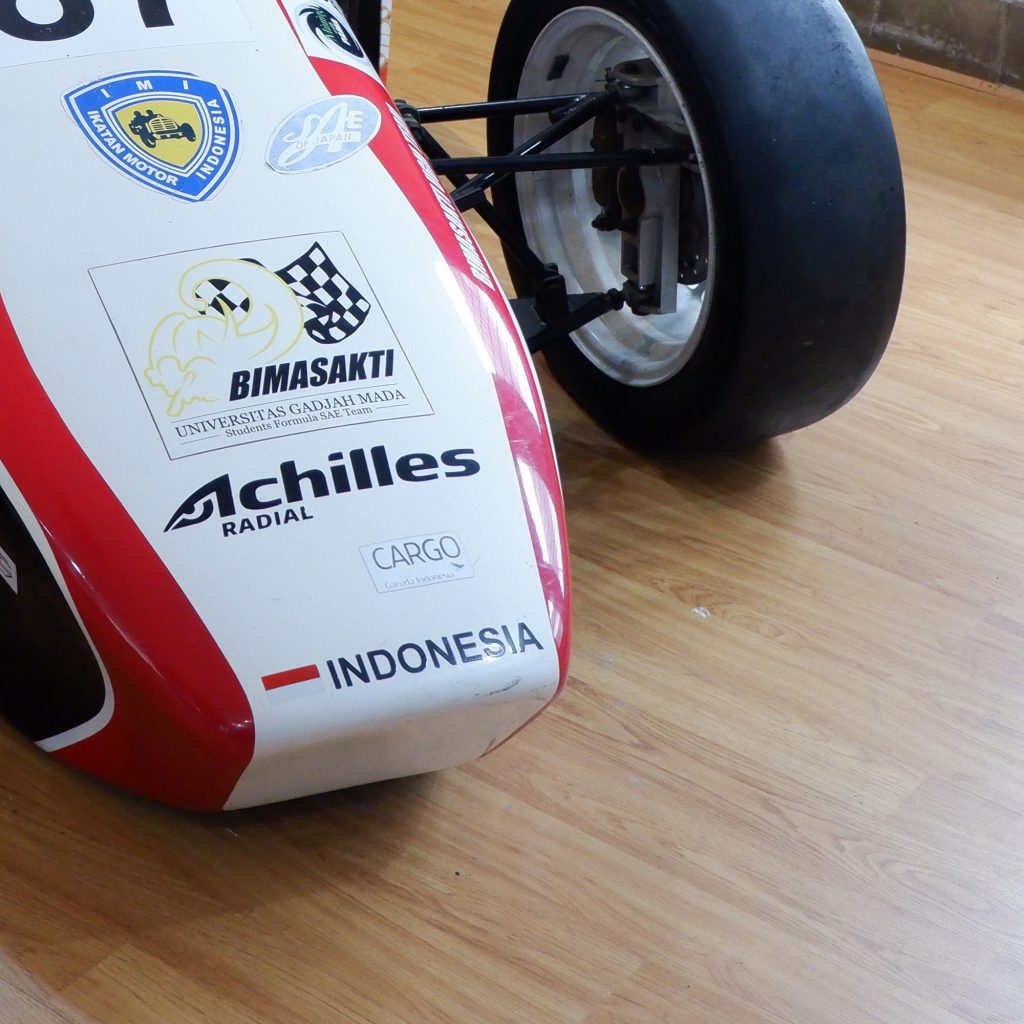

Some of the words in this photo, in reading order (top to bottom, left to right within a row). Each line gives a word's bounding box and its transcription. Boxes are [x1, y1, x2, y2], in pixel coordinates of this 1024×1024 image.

[87, 110, 126, 154] IKATAN
[123, 152, 179, 186] MOTOR
[195, 98, 227, 180] INDONESIA
[229, 348, 395, 402] BIMASAKTI
[175, 404, 287, 439] UNIVERSITAS
[288, 392, 356, 415] GADJAH
[357, 388, 406, 405] MADA
[225, 420, 273, 438] Students
[275, 413, 319, 429] Formula
[320, 409, 343, 421] SAE
[345, 405, 373, 418] Team
[162, 444, 481, 533] Achilles
[221, 505, 314, 538] RADIAL
[372, 535, 461, 570] CARGO
[326, 622, 544, 690] INDONESIA
